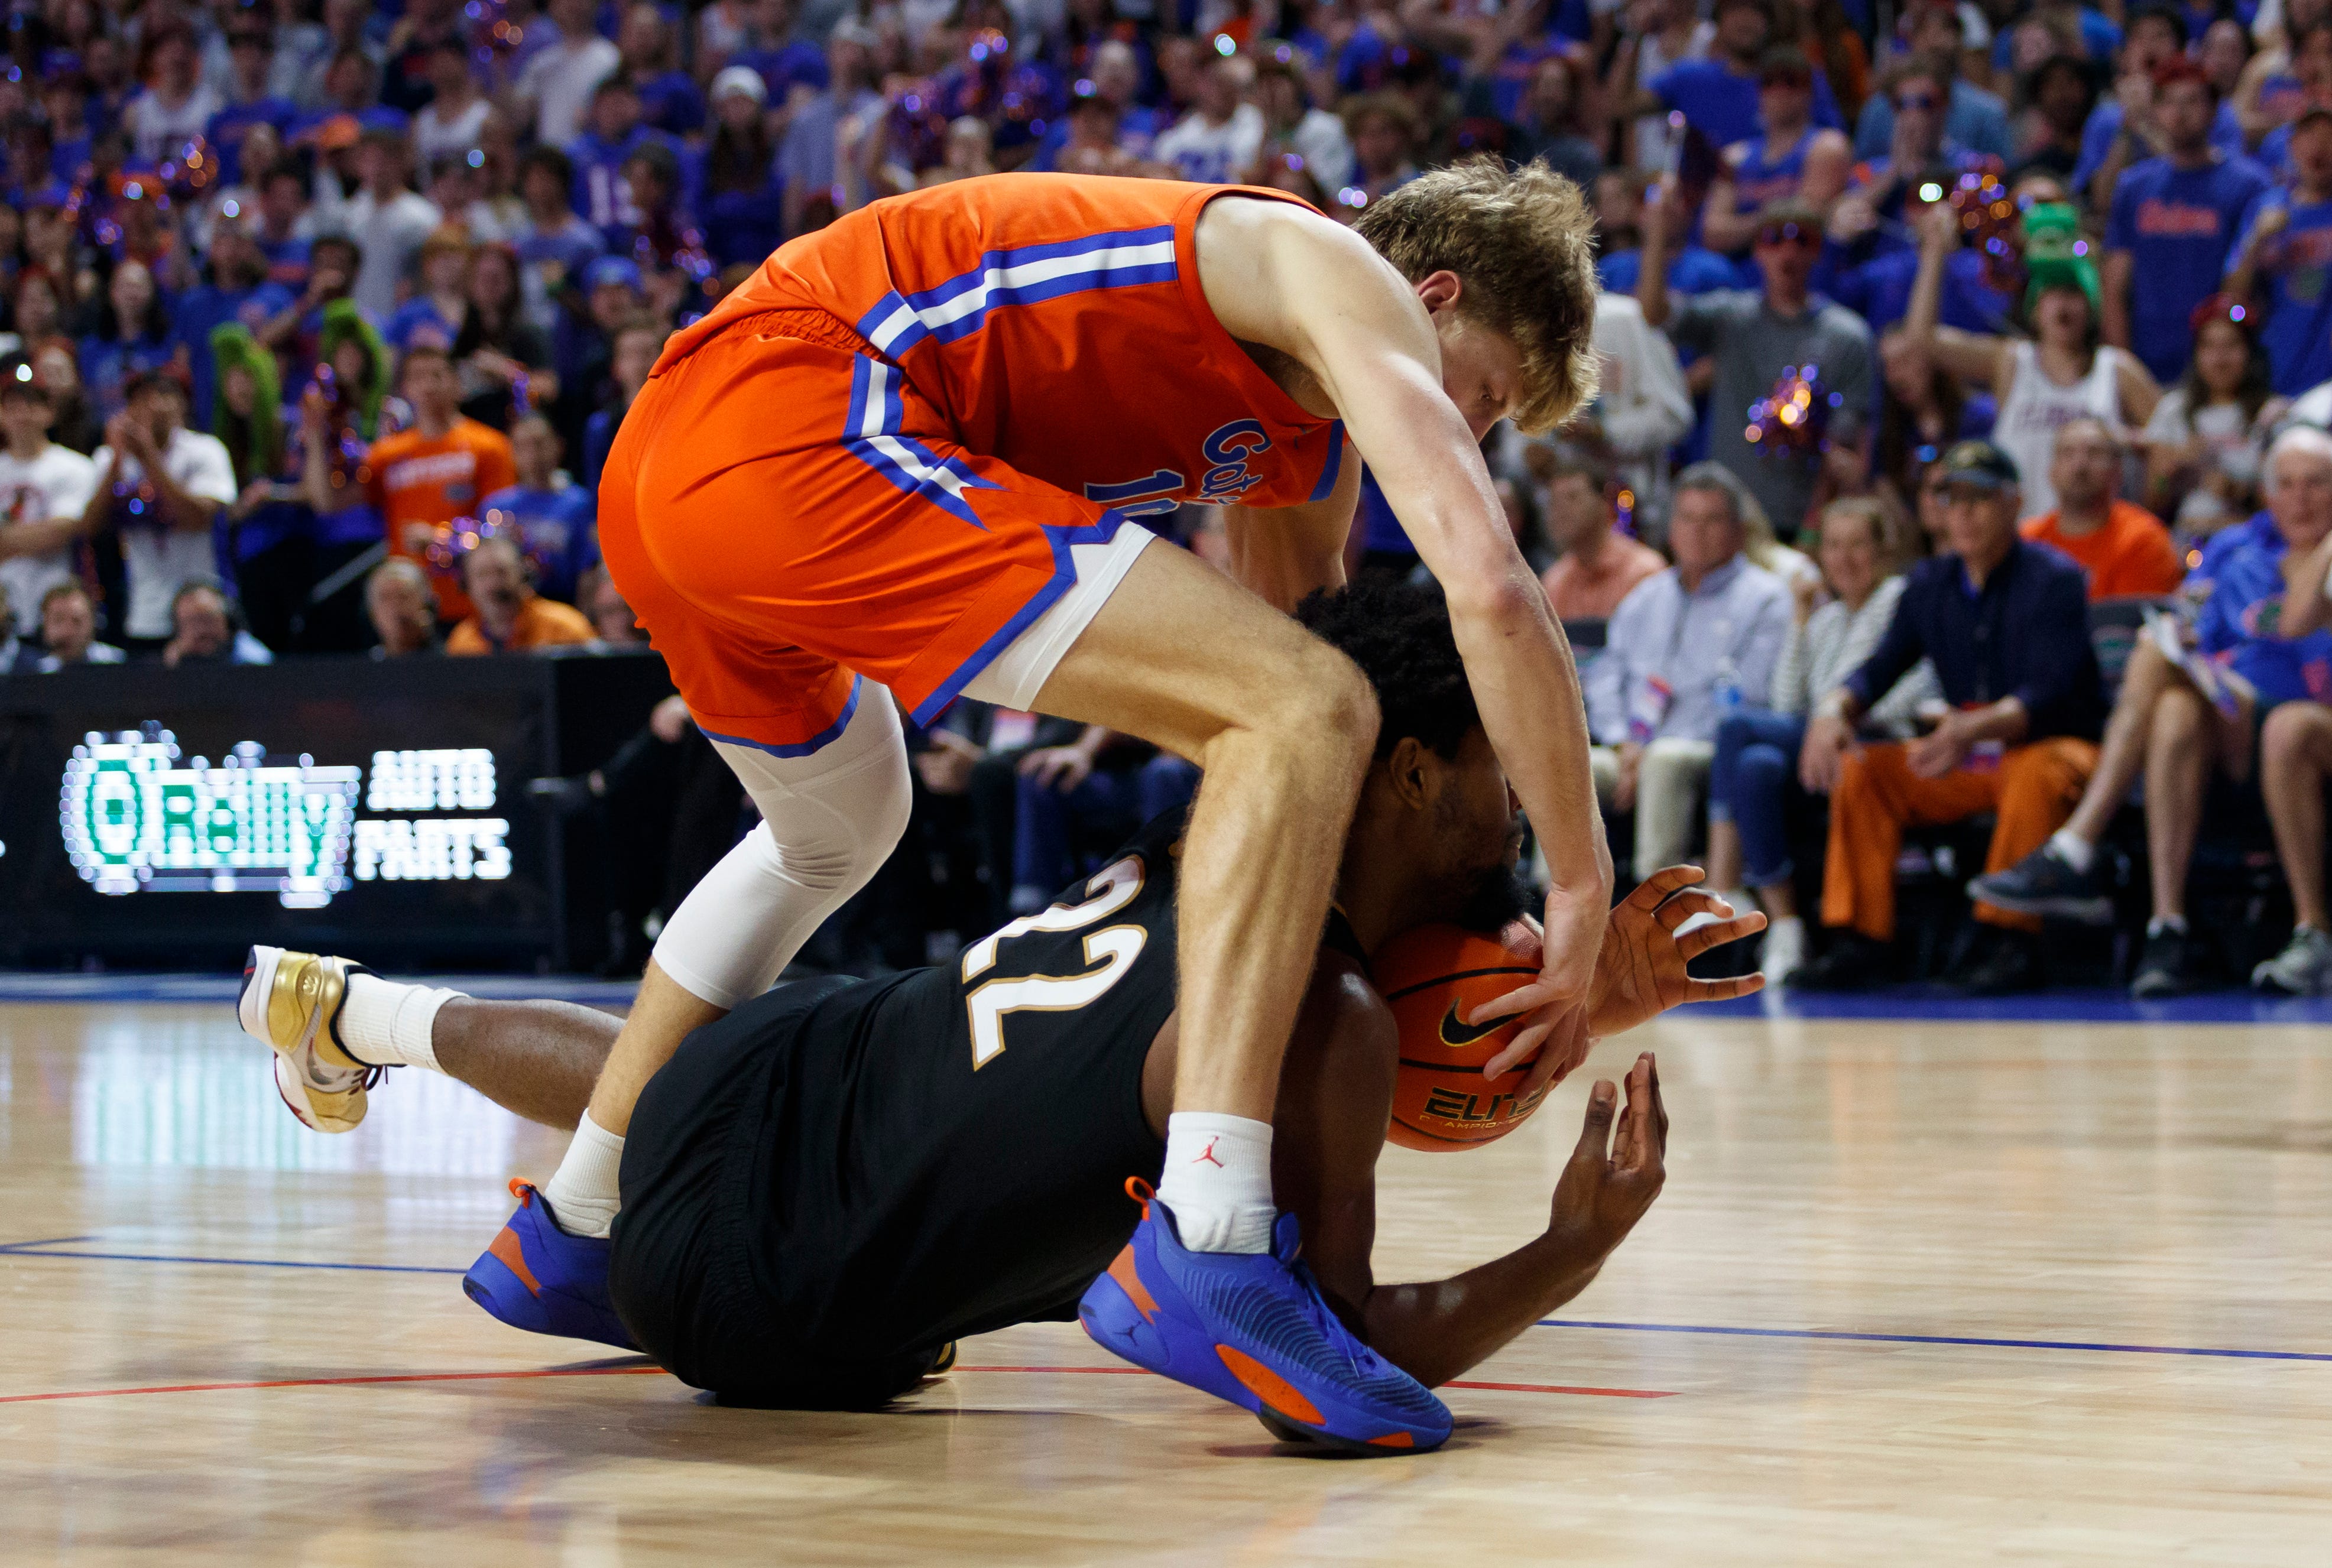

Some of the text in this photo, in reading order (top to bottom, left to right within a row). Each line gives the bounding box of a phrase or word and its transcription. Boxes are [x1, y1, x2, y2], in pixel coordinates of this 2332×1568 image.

[366, 749, 497, 811] AUTO
[353, 819, 512, 881] PARTS
[962, 855, 1147, 1072] 22
